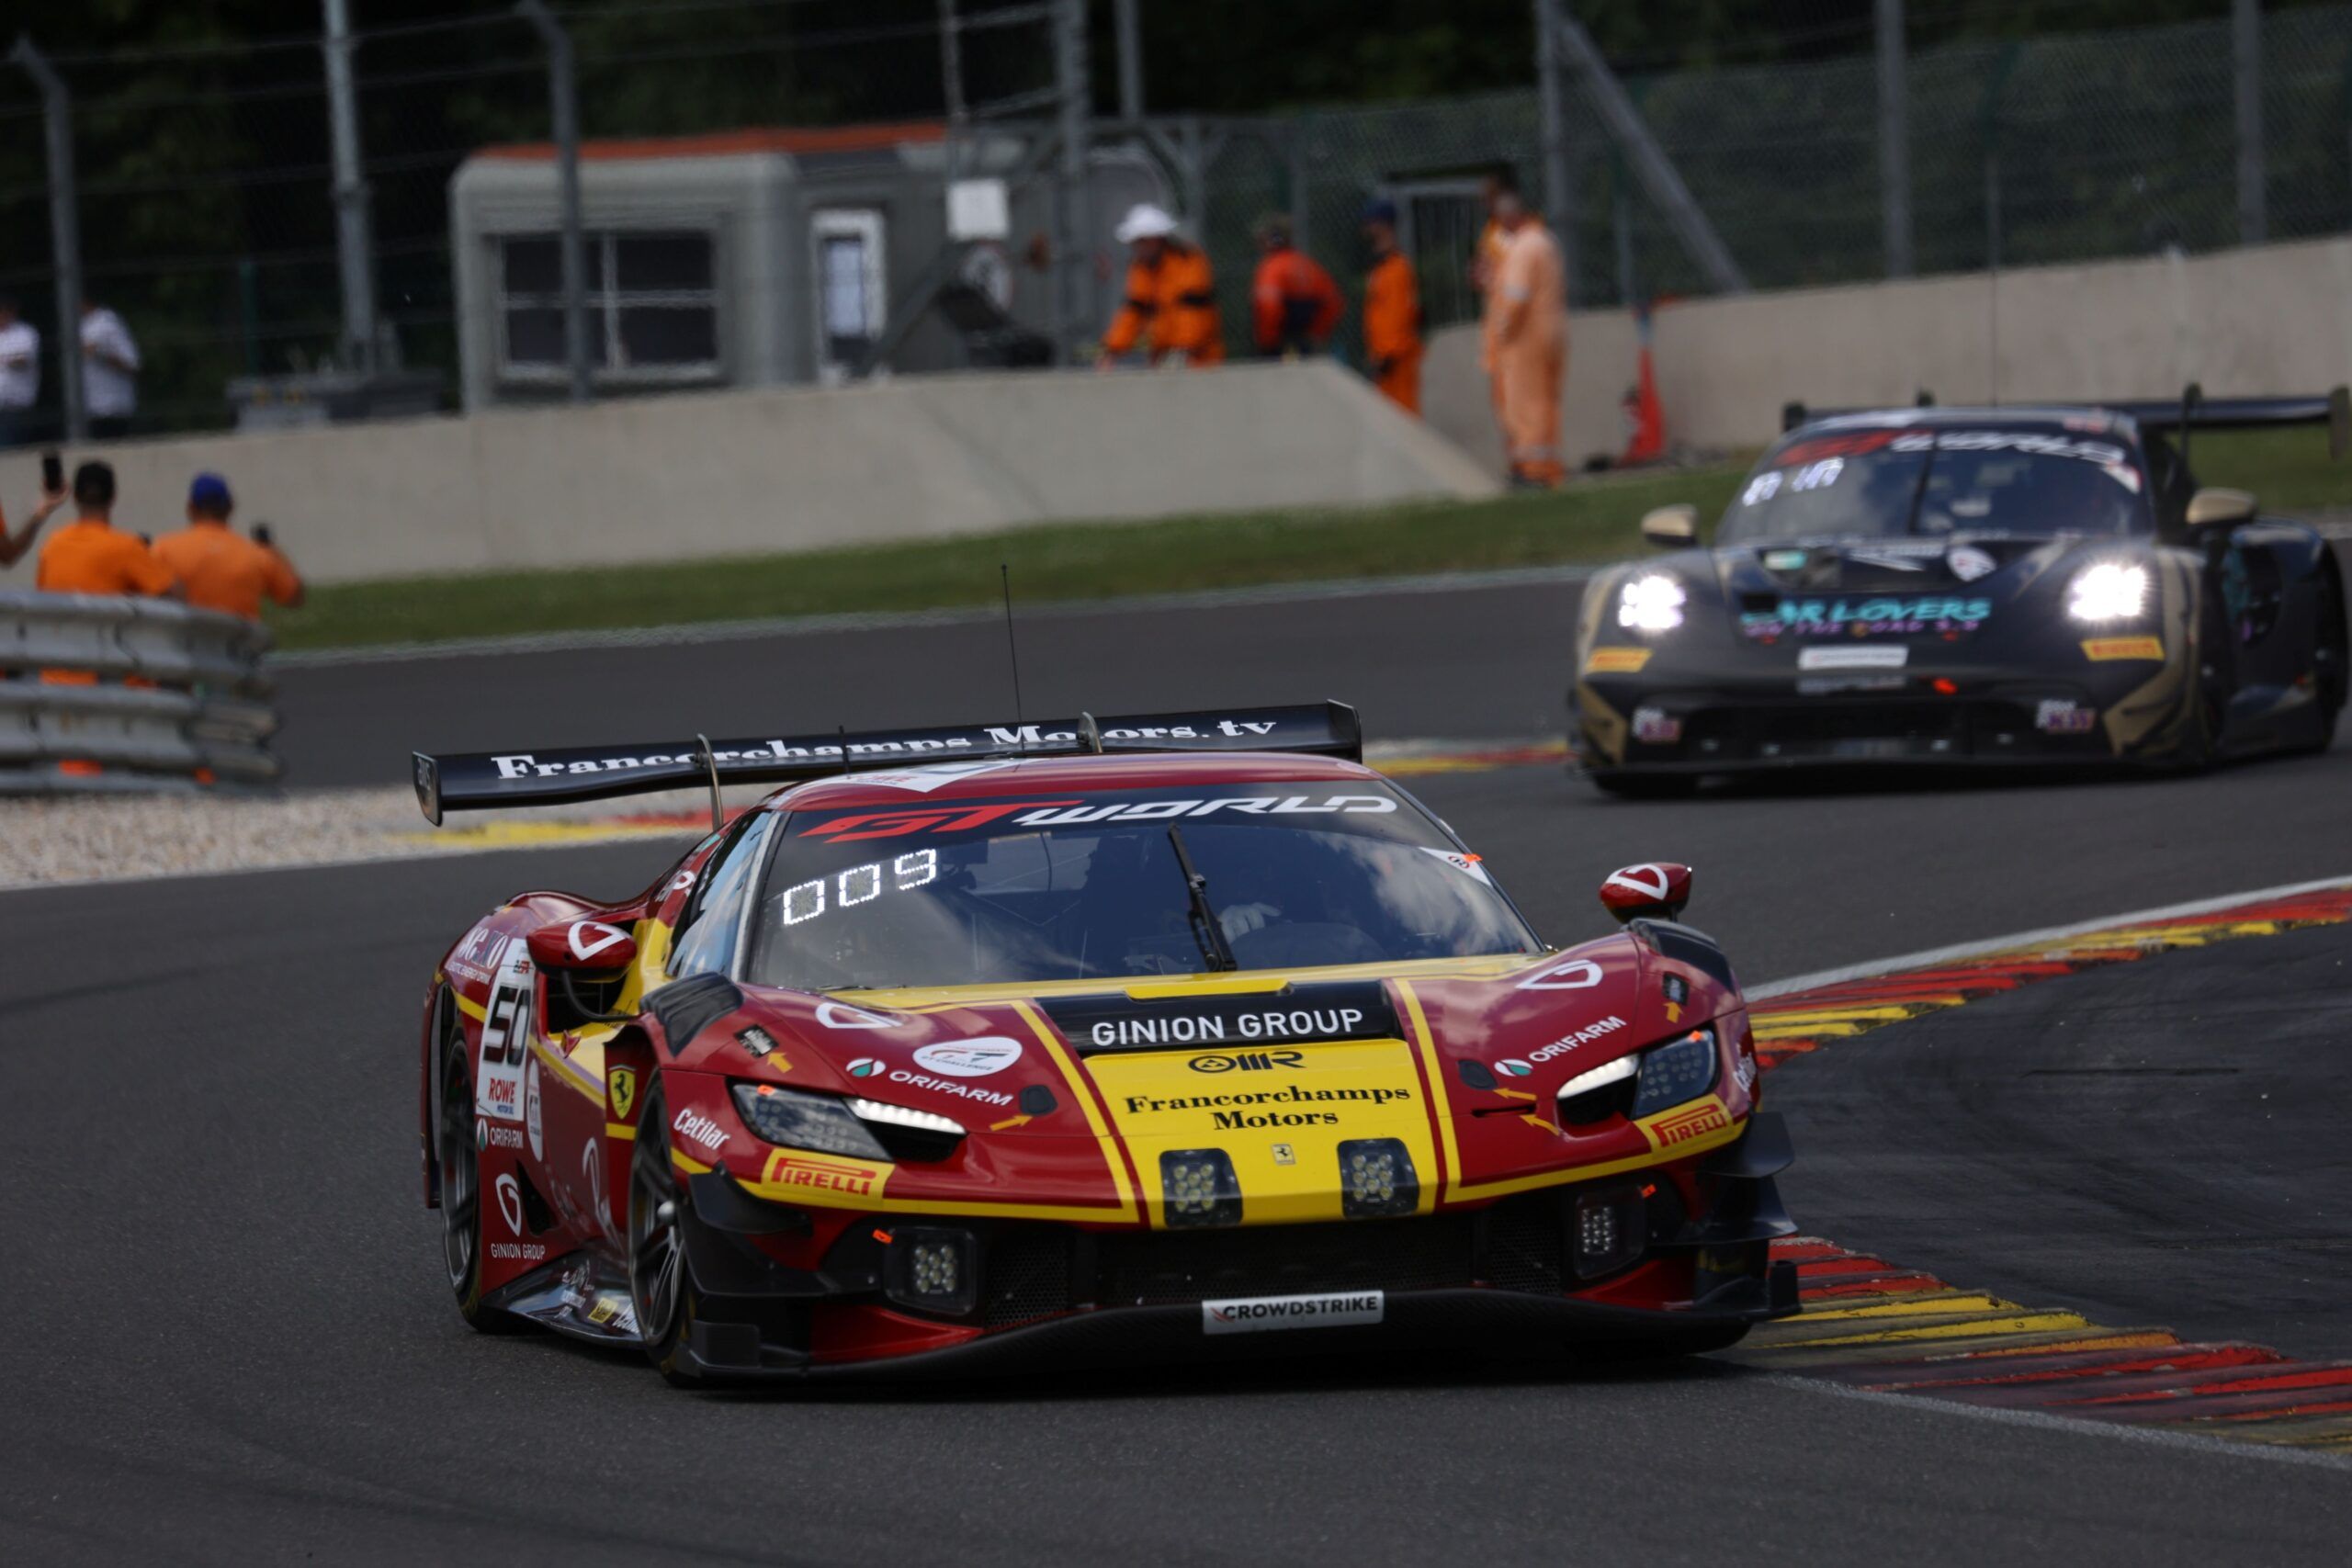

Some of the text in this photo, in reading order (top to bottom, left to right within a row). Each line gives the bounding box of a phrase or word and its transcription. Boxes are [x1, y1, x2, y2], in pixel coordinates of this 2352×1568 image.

[491, 719, 1276, 779] Francorchamps Moors.tv
[797, 795, 1397, 843] GT WORLD
[784, 848, 937, 925] 009
[1091, 1008, 1364, 1047] GINION GROUP
[1528, 1015, 1627, 1064] ORIFARM
[488, 1077, 517, 1103] ROWE
[888, 1069, 1013, 1107] ORIFARM
[1123, 1084, 1411, 1114] Francorchamps
[490, 1126, 524, 1149] ORIFARM
[673, 1108, 731, 1150] Cetilar
[1213, 1109, 1339, 1131] Motors
[1649, 1102, 1728, 1147] PIRELLI
[770, 1156, 877, 1196] PIRELLI
[491, 1243, 546, 1260] GINION GROUP
[1223, 1295, 1379, 1322] CROWDSTRIKE
